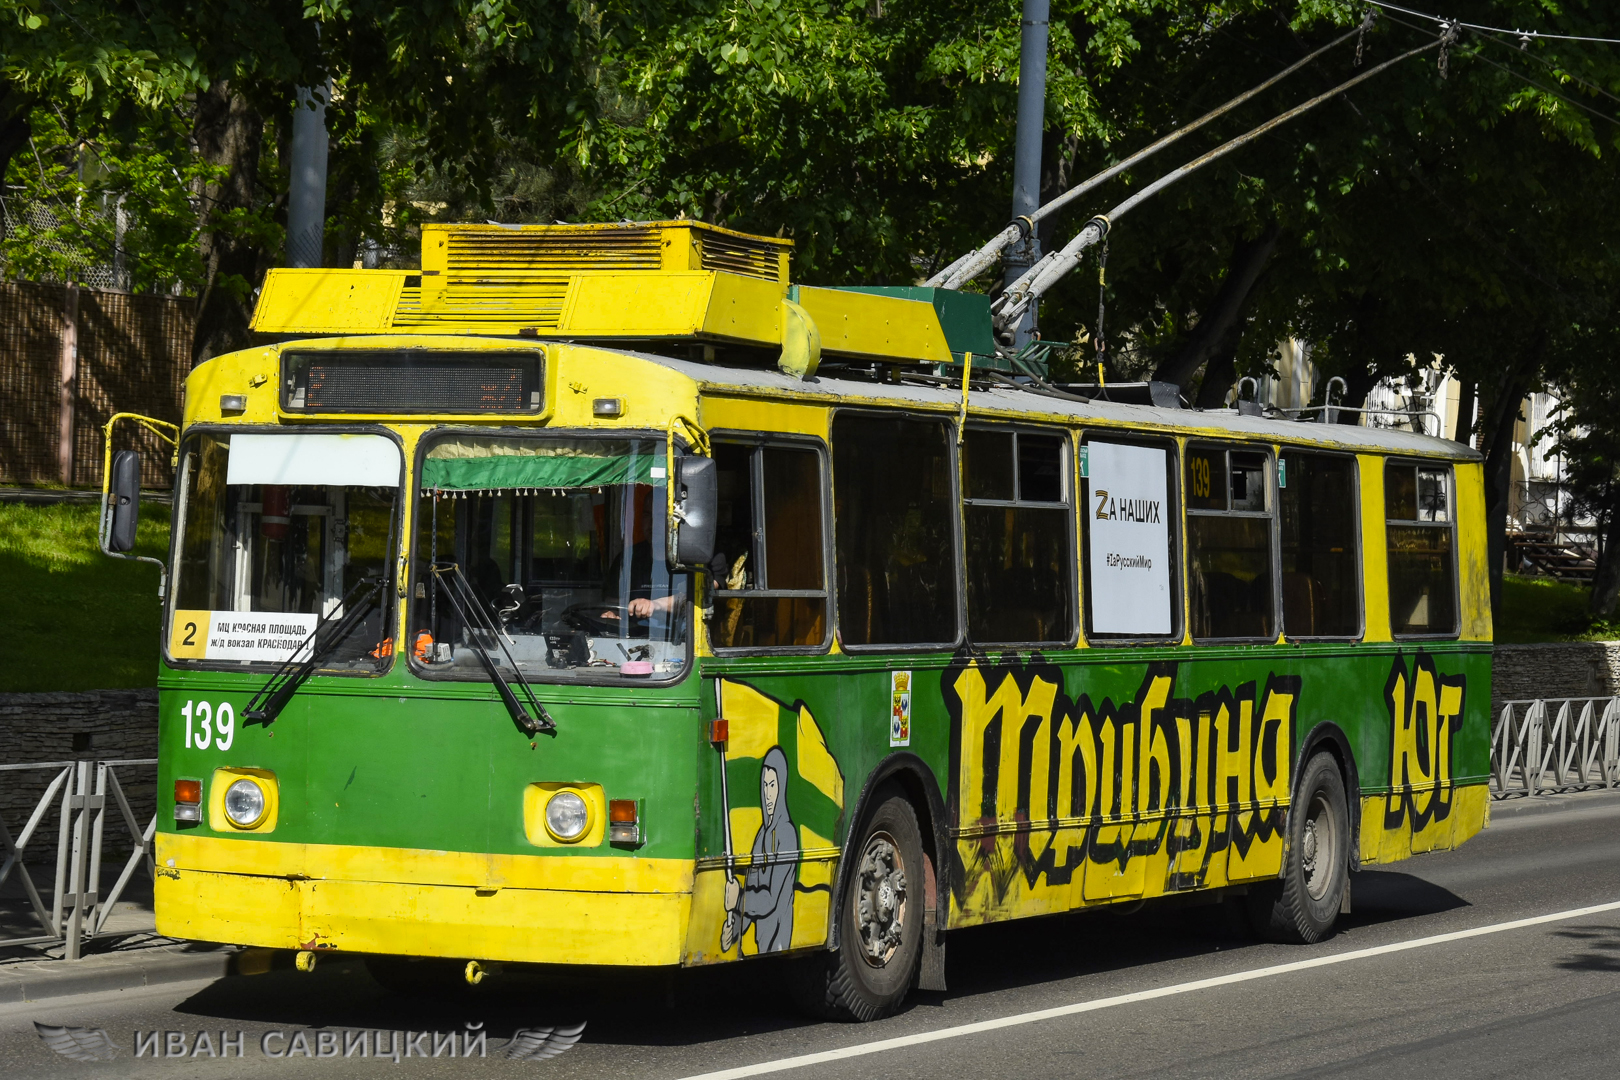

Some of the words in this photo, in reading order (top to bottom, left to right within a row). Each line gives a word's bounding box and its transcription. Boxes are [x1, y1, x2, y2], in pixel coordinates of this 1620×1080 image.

[1190, 456, 1211, 498] 139
[1119, 497, 1161, 524] НАШИХ
[182, 621, 198, 646] 2
[217, 622, 230, 634] МЦ
[232, 622, 267, 634] КРАСНАЯ
[268, 623, 307, 636] ПЛОЩАДЬ
[210, 637, 225, 649] ж/д
[227, 638, 255, 649] вокзал
[181, 700, 235, 751] 139
